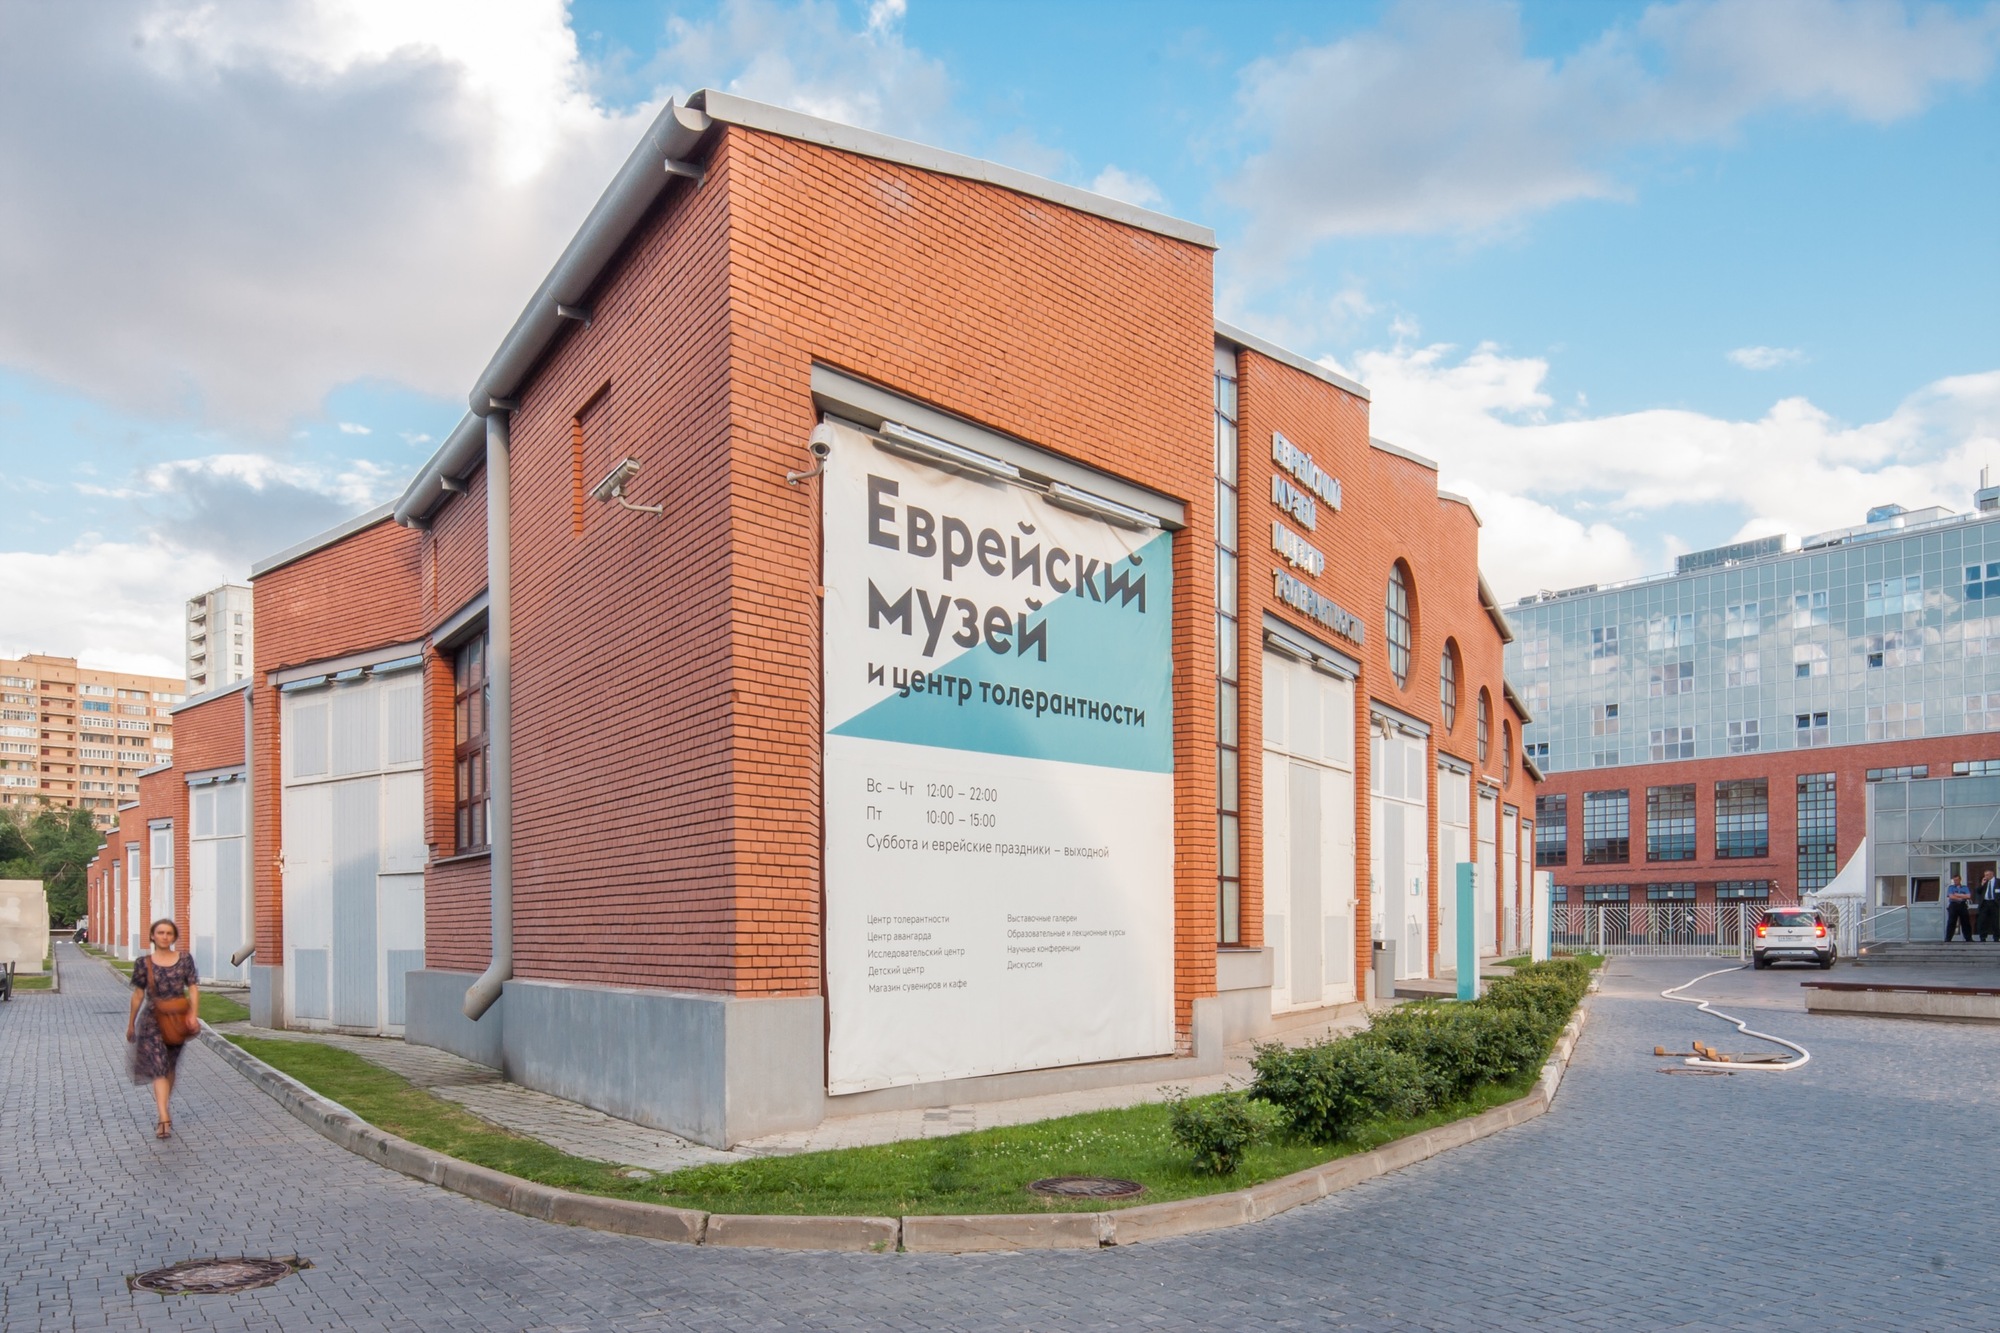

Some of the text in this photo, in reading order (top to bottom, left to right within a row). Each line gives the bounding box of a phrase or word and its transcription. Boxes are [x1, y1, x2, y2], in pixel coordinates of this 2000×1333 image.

[1271, 431, 1342, 512] ЕВРЕЙСКИЙ
[1271, 474, 1316, 532] МУЗЕЙ
[867, 473, 1146, 613] Еврейский
[868, 577, 1047, 662] музей
[868, 662, 1145, 728] и центр толерантности
[866, 777, 882, 793] Вс
[899, 780, 914, 795] Чт
[926, 783, 954, 799] 12:00
[969, 786, 997, 802] 22:00
[866, 805, 882, 820] Пт
[926, 809, 954, 825] 10:00
[970, 813, 996, 828] 15:00
[866, 833, 918, 852] Суббота
[922, 840, 929, 850] и
[931, 838, 992, 854] еврейские
[994, 843, 1051, 857] праздники
[1064, 846, 1110, 859] выходной
[867, 914, 950, 926] Центр толерантности
[867, 932, 932, 943] Центр авангарда
[1037, 944, 1081, 954] конференции
[867, 947, 966, 959] Исследовательский центр
[868, 965, 925, 977] Детский центр
[1006, 960, 1043, 970] Дискуссии
[868, 983, 901, 993] Магазин
[902, 981, 942, 992] сувениров
[948, 979, 968, 990] кафе
